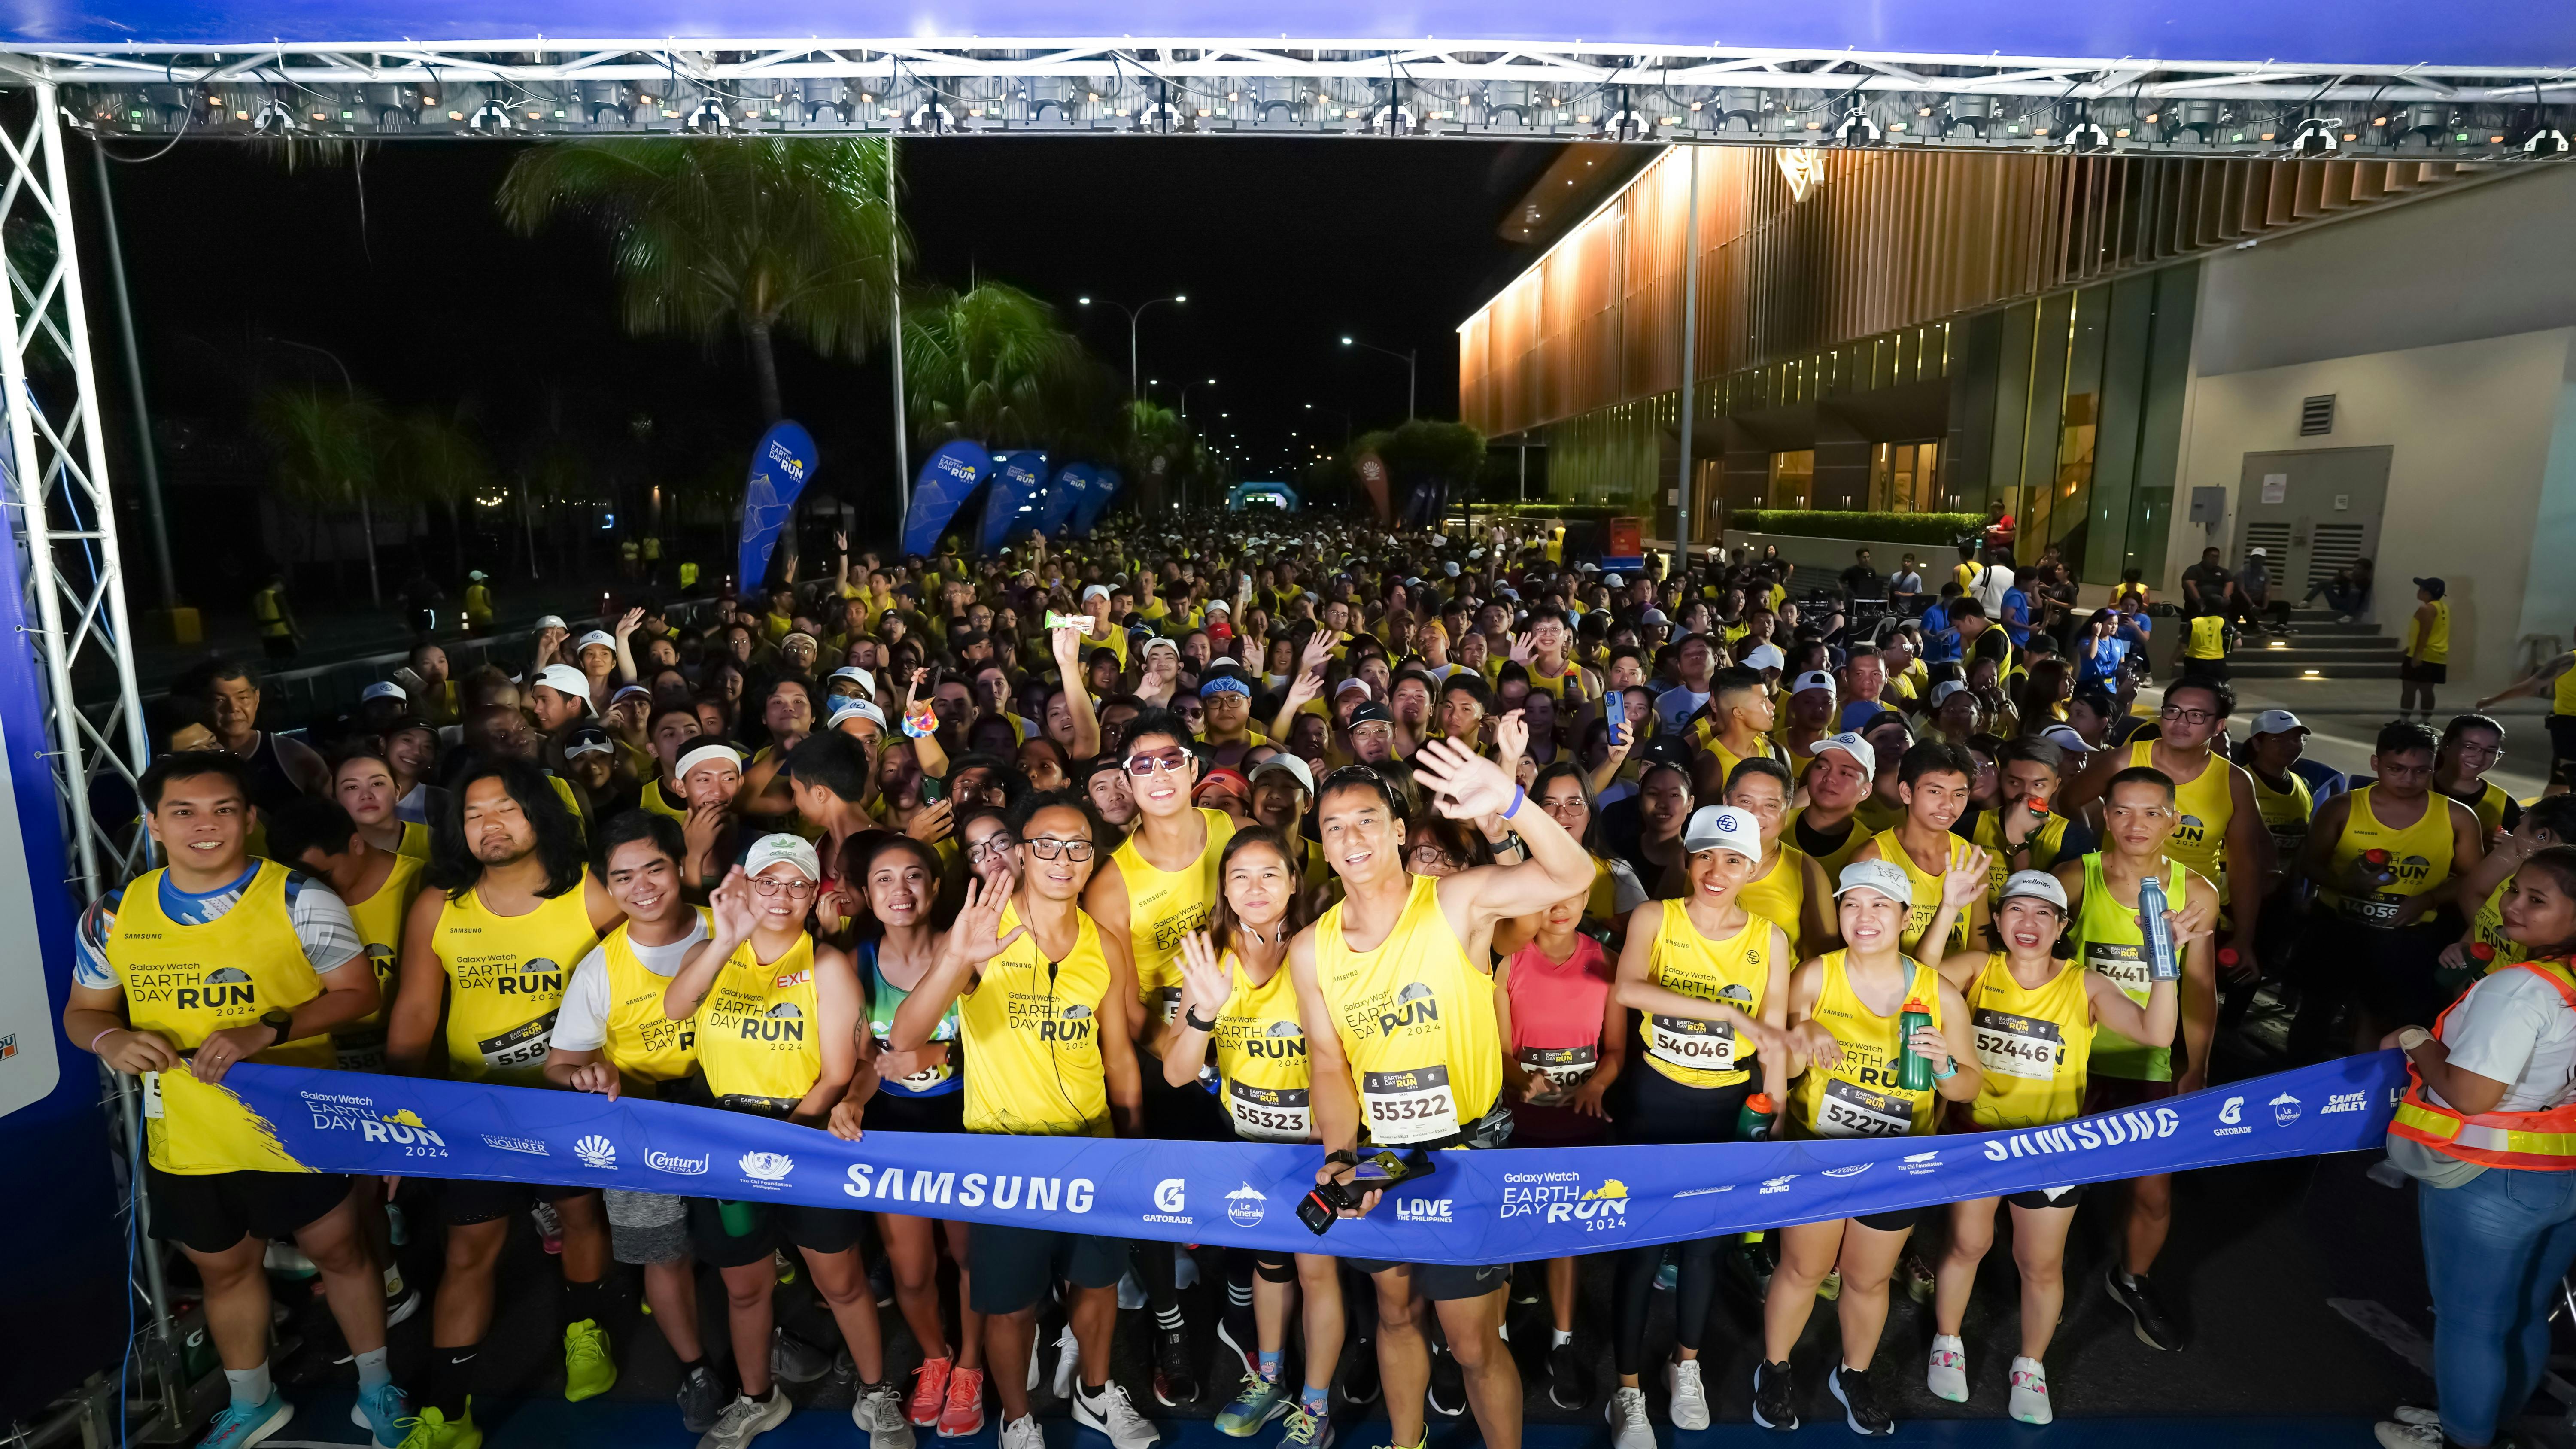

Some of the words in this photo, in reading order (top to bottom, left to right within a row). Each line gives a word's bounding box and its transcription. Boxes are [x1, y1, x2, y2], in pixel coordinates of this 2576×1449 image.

[771, 444, 791, 462] EARTH
[769, 451, 782, 463] DAY
[781, 459, 803, 479] RUN
[939, 458, 962, 469] EARTH
[938, 463, 951, 471] DAY
[951, 468, 976, 481] RUN
[1016, 475, 1035, 485] RUN
[1070, 480, 1086, 489] RUN
[2023, 878, 2051, 889] wellman
[1139, 889, 1168, 908] SAMSUNG
[1153, 914, 1179, 930] Galaxy
[1179, 901, 1203, 917] Watch
[1155, 909, 1208, 941] EARTH
[2144, 915, 2155, 959] smartwater
[2482, 926, 2511, 956] RUN
[129, 963, 164, 974] Galaxy
[167, 962, 200, 970] Watch
[458, 963, 517, 978] EARTH
[1002, 960, 1032, 969] SAMSUNG
[131, 973, 201, 987] EARTH
[777, 971, 810, 988] EXL
[1332, 970, 1358, 983] AMSUNG
[1664, 965, 1690, 978] Galaxy
[1691, 972, 1716, 982] Watch
[459, 977, 495, 989] DAY
[498, 973, 562, 995] RUN
[1660, 975, 1715, 995] EARTH
[134, 989, 173, 1003] DAY
[178, 984, 255, 1009] RUN
[530, 992, 562, 1002] 2024
[626, 992, 657, 1006] SAMSUNG
[720, 987, 743, 1002] Galaxy
[1008, 992, 1036, 1004] Galaxy
[1036, 995, 1060, 1003] Watch
[216, 1006, 256, 1017] 2024
[714, 997, 764, 1017] EARTH
[1008, 1002, 1060, 1019] EARTH
[1344, 998, 1370, 1012] Galaxy
[1345, 995, 1395, 1028] EARTH
[1216, 1013, 1238, 1024] Galaxy
[1379, 999, 1439, 1037] RUN
[1823, 1009, 1853, 1019] SAMSUNG
[522, 1024, 542, 1038] RUN
[638, 1017, 667, 1030] Galaxy
[641, 1018, 696, 1042] EARTH
[710, 1013, 742, 1029] DAY
[741, 1019, 804, 1042] RUN
[1010, 1016, 1039, 1031] DAY
[1040, 1019, 1091, 1041] RUN
[1407, 1023, 1441, 1036] 2024
[2009, 1023, 2029, 1032] RUN
[510, 1027, 527, 1038] EARTH
[1215, 1025, 1262, 1038] EARTH
[645, 1035, 676, 1051] DAY
[770, 1043, 802, 1051] 2024
[1065, 1040, 1089, 1050] 2024
[1218, 1038, 1243, 1050] DAY
[1247, 1037, 1306, 1059] RUN
[1657, 1033, 1729, 1058] 54046
[1856, 1042, 1883, 1054] Watch
[1976, 1033, 2049, 1062] 52446
[1277, 1057, 1308, 1068] 2024
[1396, 1078, 1418, 1088] RUN
[301, 1091, 337, 1105] Galaxy
[338, 1095, 373, 1106] Watch
[1856, 1090, 1874, 1100] EARTH
[2328, 1089, 2366, 1106] SANTÉ
[305, 1100, 380, 1121] EARTH
[752, 1103, 772, 1112] RUN
[1372, 1094, 1449, 1121] 55322
[1865, 1098, 1886, 1109] RUN
[2320, 1100, 2368, 1115] BARLEY
[1236, 1103, 1303, 1130] 55323
[1827, 1103, 1902, 1137] 52275
[313, 1114, 358, 1131] DAY
[360, 1119, 445, 1147] RUN
[481, 1134, 521, 1142] PHILIPPINE
[1984, 1107, 2180, 1161] SAMSUNG
[2214, 1126, 2252, 1136] GATORADE
[405, 1146, 448, 1158] 2024
[483, 1137, 547, 1153] INQUIRER
[649, 1151, 704, 1172] Century
[1504, 1173, 1544, 1185] Galaxy
[1544, 1171, 1580, 1182] Watch
[844, 1163, 1095, 1214] SAMSUNG
[1503, 1185, 1580, 1204] EARTH
[1760, 1185, 1789, 1195] RUNRIO
[1229, 1209, 1263, 1218] Minerale
[1241, 1202, 1250, 1210] Le
[1396, 1197, 1453, 1216] LOVE
[1500, 1202, 1548, 1218] DAY
[1547, 1197, 1631, 1224] RUN
[1143, 1214, 1193, 1224] GATORADE
[1586, 1218, 1627, 1232] 2024
